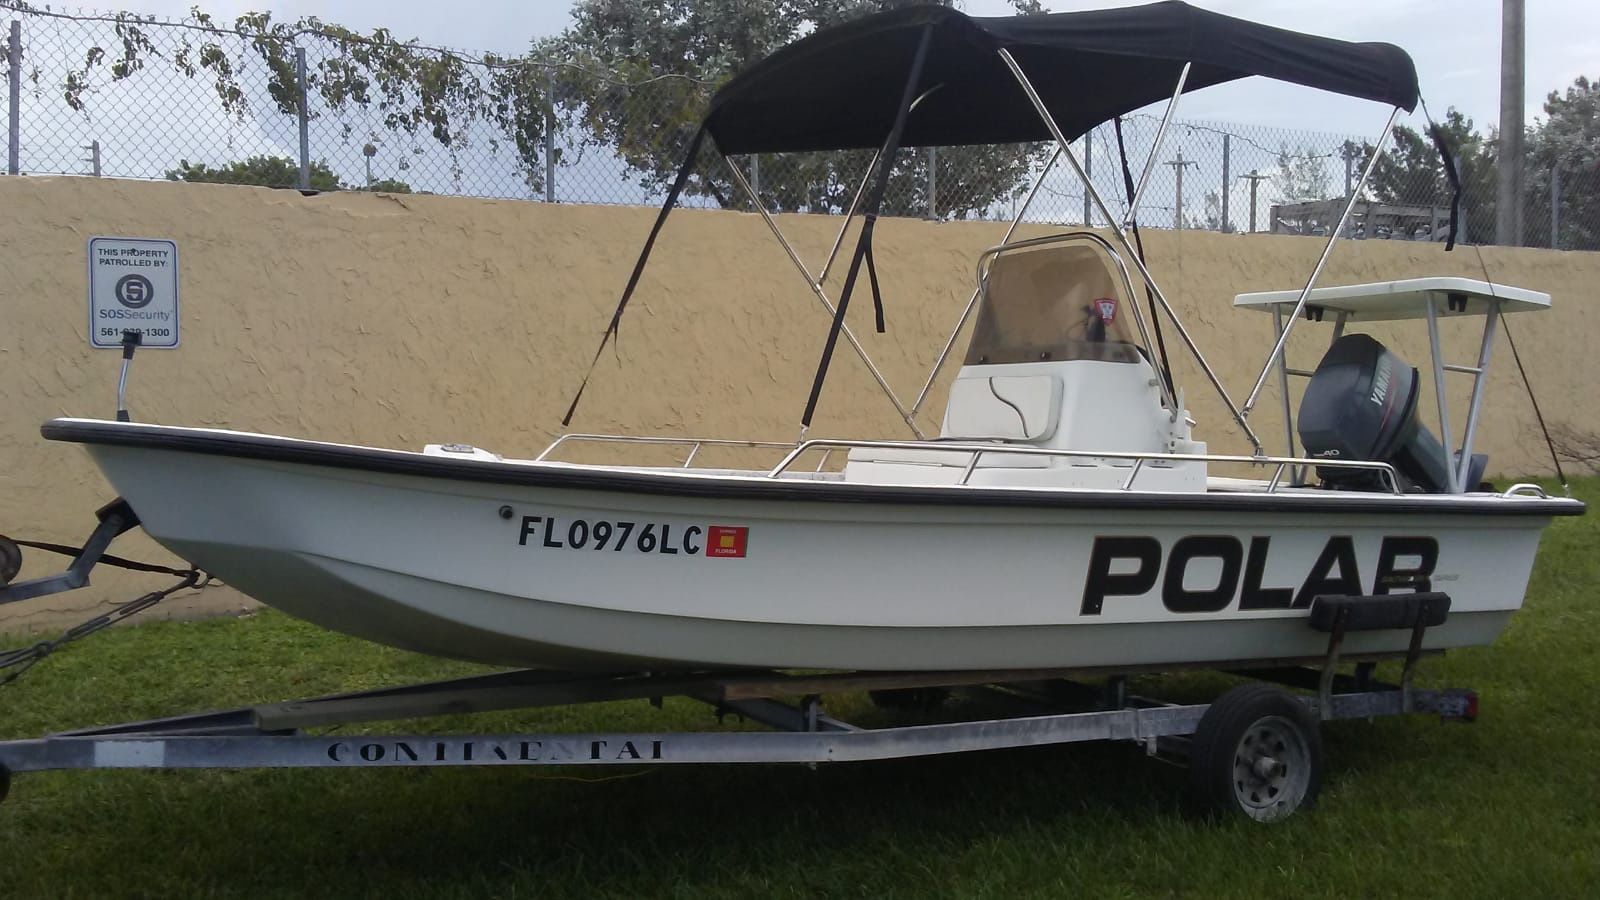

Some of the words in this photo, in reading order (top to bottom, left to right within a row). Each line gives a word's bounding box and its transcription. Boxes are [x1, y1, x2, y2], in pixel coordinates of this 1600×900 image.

[98, 248, 119, 256] THIS
[120, 249, 169, 257] PROPERTY
[99, 258, 152, 267] PATROLLED
[518, 515, 702, 555] FL0976LC
[1079, 534, 1440, 617] POLAR
